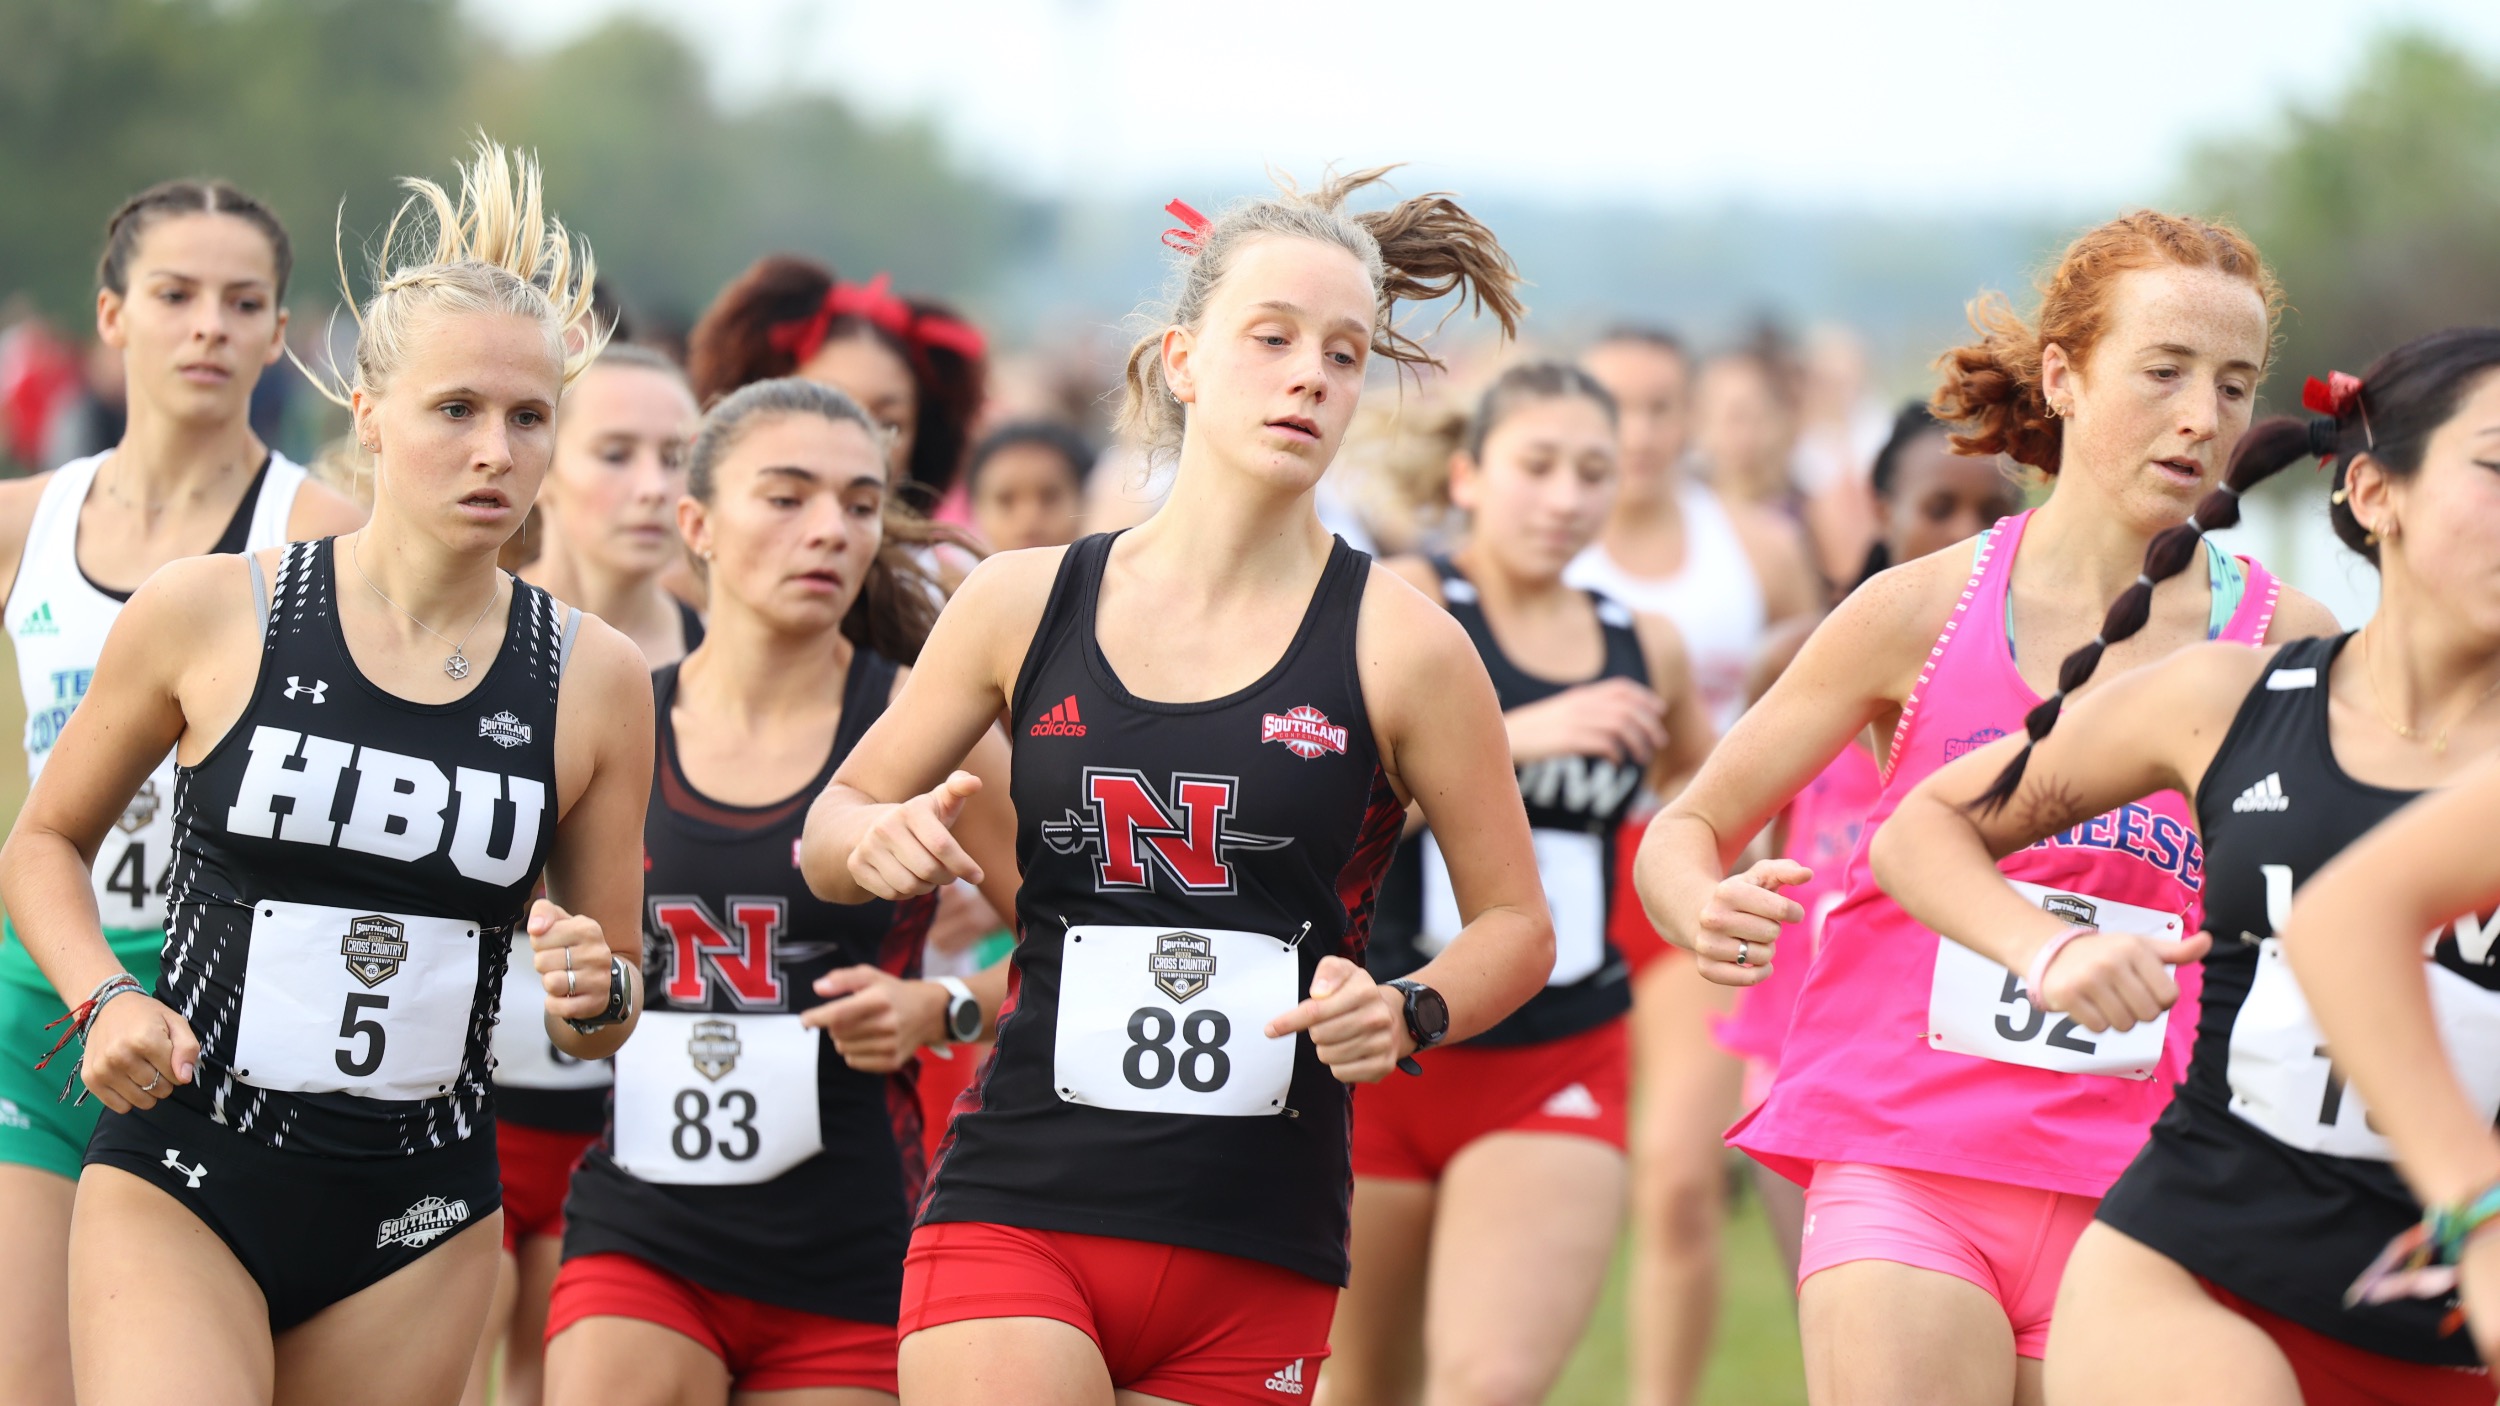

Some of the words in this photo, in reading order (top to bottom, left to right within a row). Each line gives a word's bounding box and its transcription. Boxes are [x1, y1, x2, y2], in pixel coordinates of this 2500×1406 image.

[1955, 543, 1996, 612] ARMOUR
[1918, 621, 1958, 685] UNDER
[480, 718, 530, 741] SOUTHLAND
[1030, 720, 1087, 737] adidas
[1264, 715, 1346, 751] SOUTHLAND
[226, 725, 545, 888] HBU
[1084, 768, 1237, 894] N
[106, 842, 174, 908] 4
[346, 940, 370, 954] CROSS
[371, 942, 403, 957] COUNTRY
[356, 923, 398, 938] SOUTHLAND
[649, 896, 787, 1009] N
[1162, 940, 1206, 954] SOUTHLAND
[1154, 957, 1178, 970] CROSS
[1178, 958, 1212, 972] COUNTRY
[335, 992, 390, 1076] 5
[1122, 1006, 1231, 1093] 88
[672, 1088, 760, 1162] 83
[380, 1202, 467, 1242] SOUTHLAND
[1265, 1377, 1304, 1395] adidas
